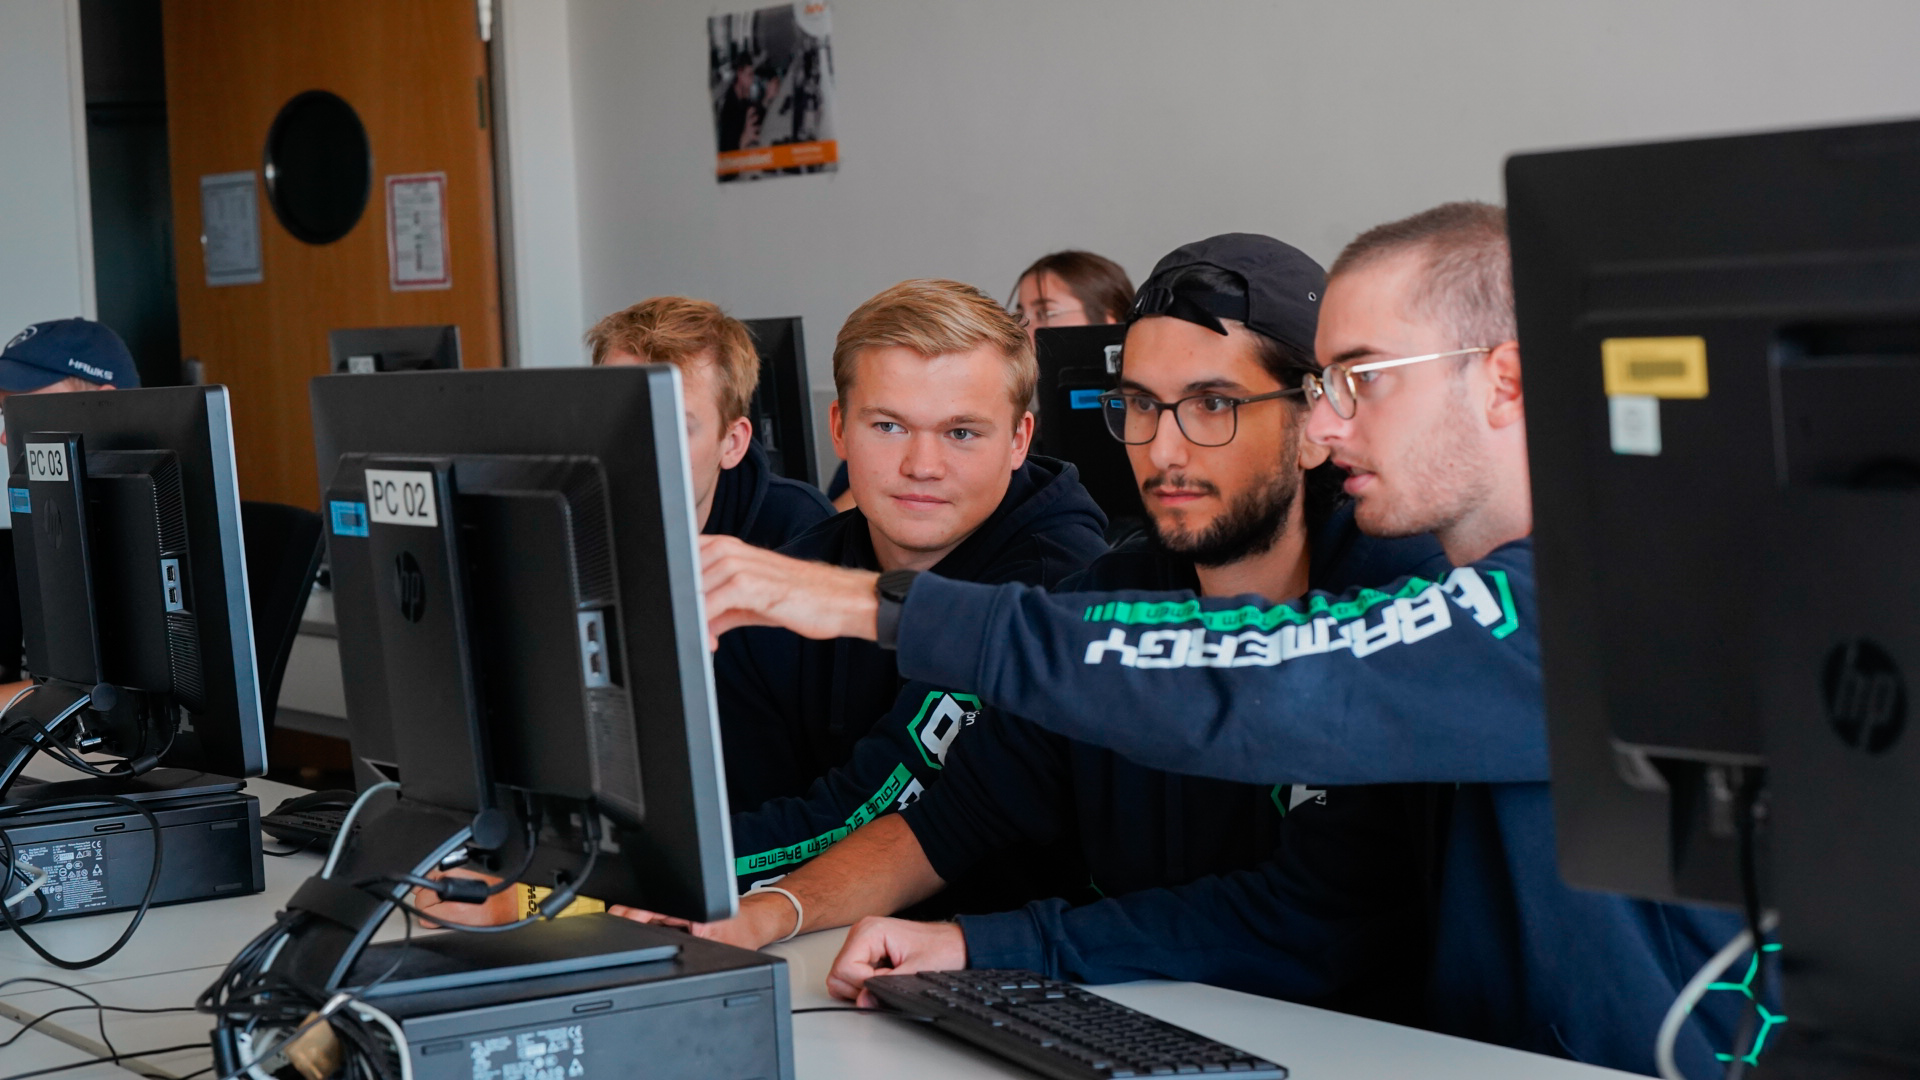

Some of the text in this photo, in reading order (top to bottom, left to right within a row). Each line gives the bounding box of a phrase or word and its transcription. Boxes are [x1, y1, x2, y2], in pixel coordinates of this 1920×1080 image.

[68, 358, 114, 381] HAWKS
[29, 450, 63, 476] PC 03
[372, 480, 399, 516] PC
[403, 482, 429, 518] 02
